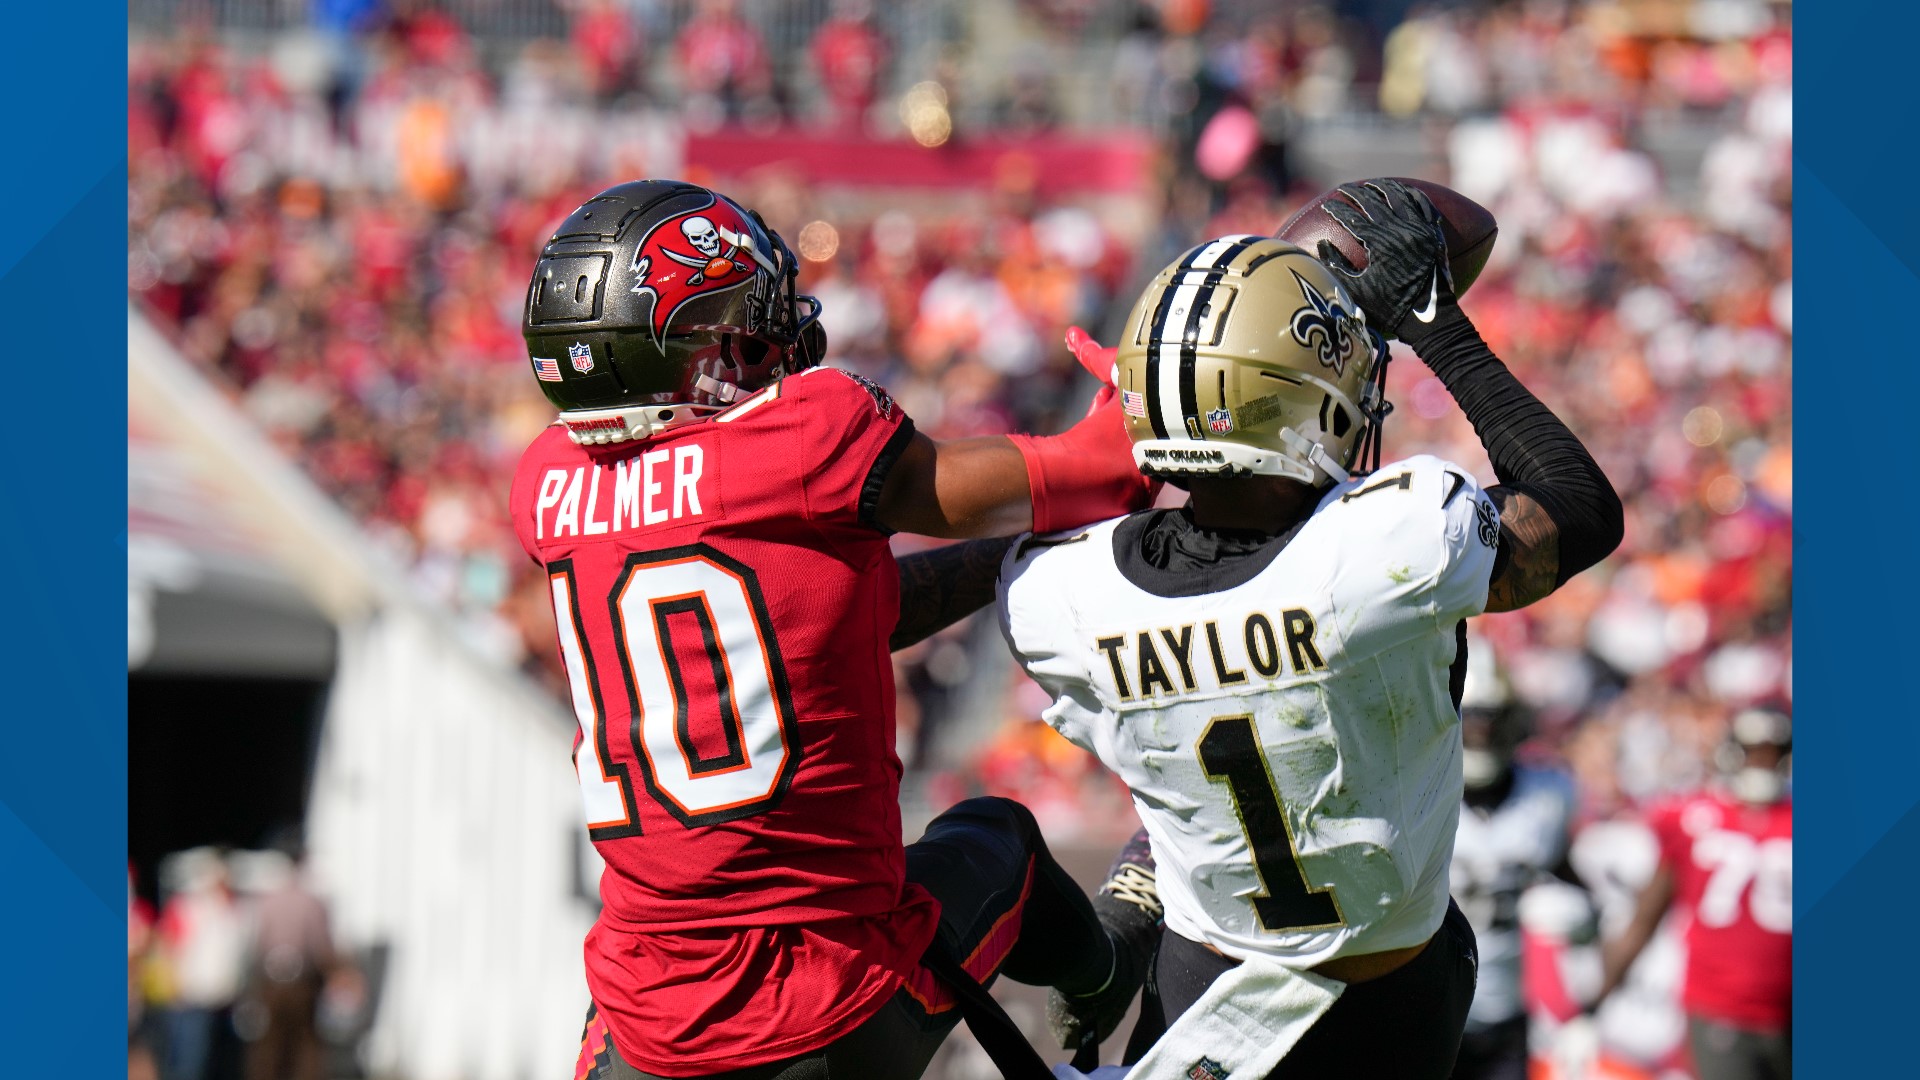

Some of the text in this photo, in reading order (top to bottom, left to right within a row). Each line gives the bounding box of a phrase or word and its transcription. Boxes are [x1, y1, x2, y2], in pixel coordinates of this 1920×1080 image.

[574, 356, 592, 369] NFL
[1168, 449, 1223, 462] ORLEANS
[1187, 417, 1202, 440] 1
[1211, 420, 1231, 432] NFL
[536, 444, 704, 540] PALMER
[1095, 606, 1328, 703] TAYLOR
[547, 543, 802, 841] 10
[1195, 713, 1346, 934] 1
